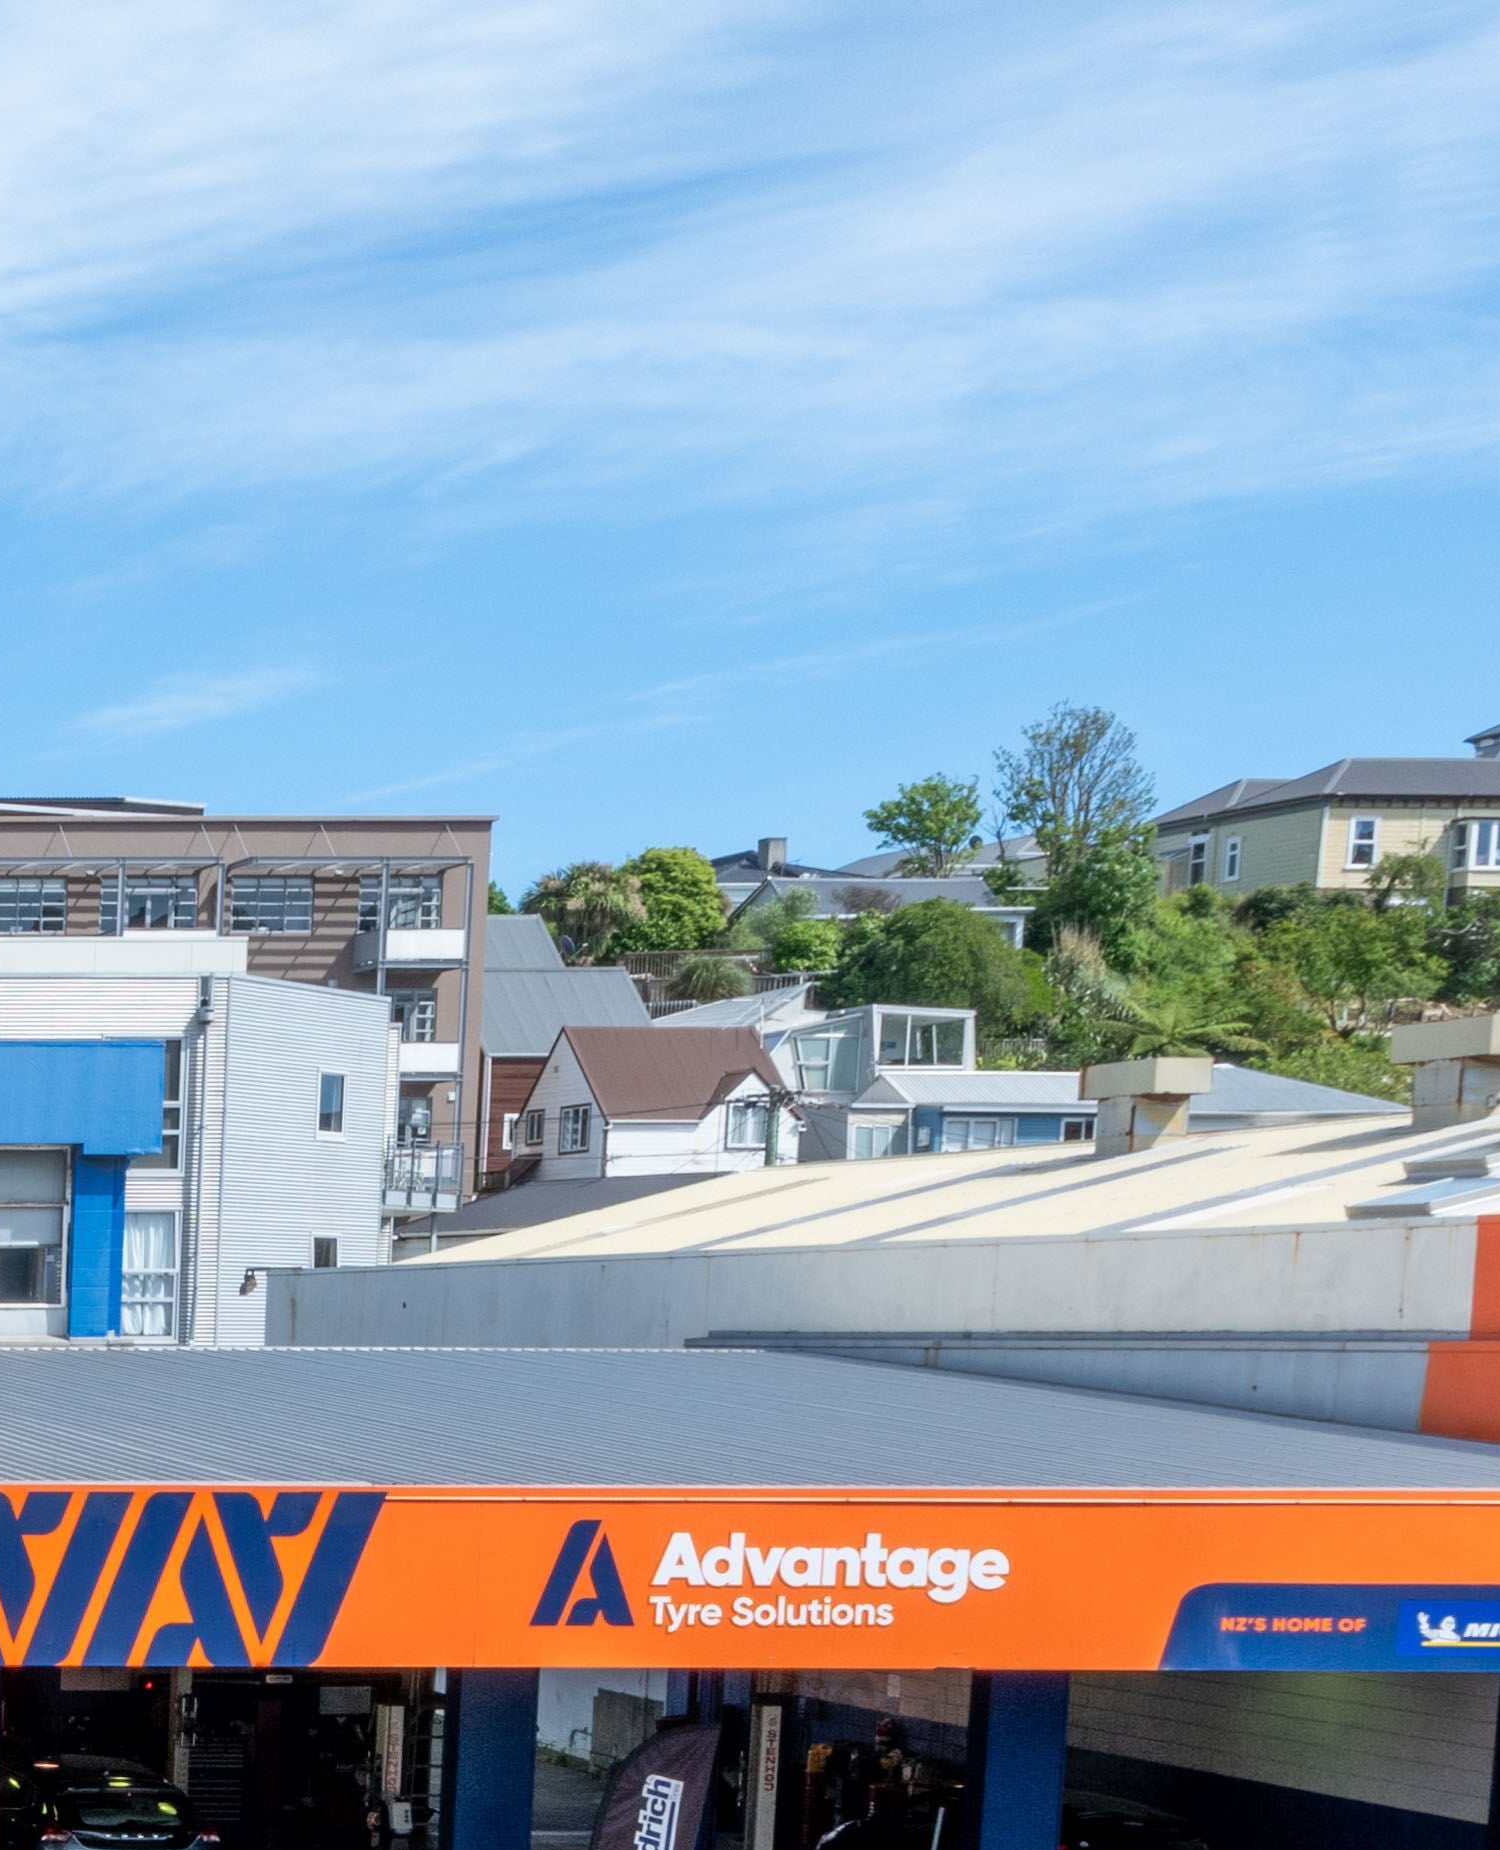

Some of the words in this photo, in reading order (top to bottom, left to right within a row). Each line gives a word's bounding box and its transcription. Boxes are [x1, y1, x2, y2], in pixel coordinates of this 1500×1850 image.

[650, 1532, 1010, 1605] Advantage
[650, 1596, 722, 1632] Tyre
[732, 1596, 895, 1627] Solutions
[1220, 1616, 1268, 1632] NZ'S
[1272, 1617, 1333, 1632] HOME
[1338, 1617, 1366, 1632] OF
